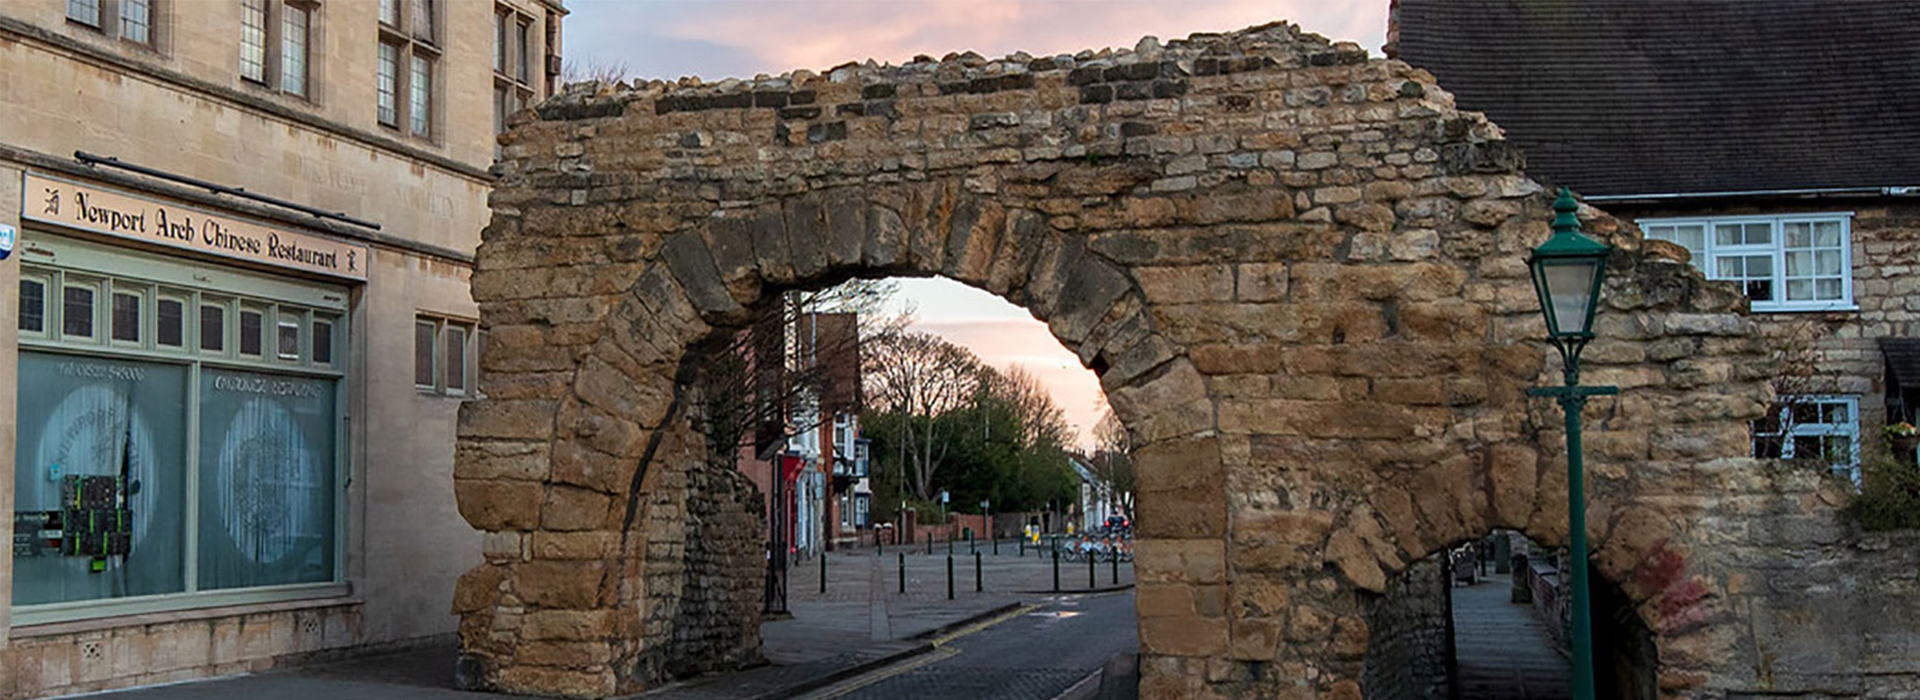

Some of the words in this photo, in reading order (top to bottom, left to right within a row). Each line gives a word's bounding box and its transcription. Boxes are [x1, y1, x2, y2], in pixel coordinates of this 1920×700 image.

[74, 191, 146, 233] Newport
[155, 208, 195, 242] Arch
[202, 219, 261, 255] Chinese
[267, 231, 337, 269] Restaurant
